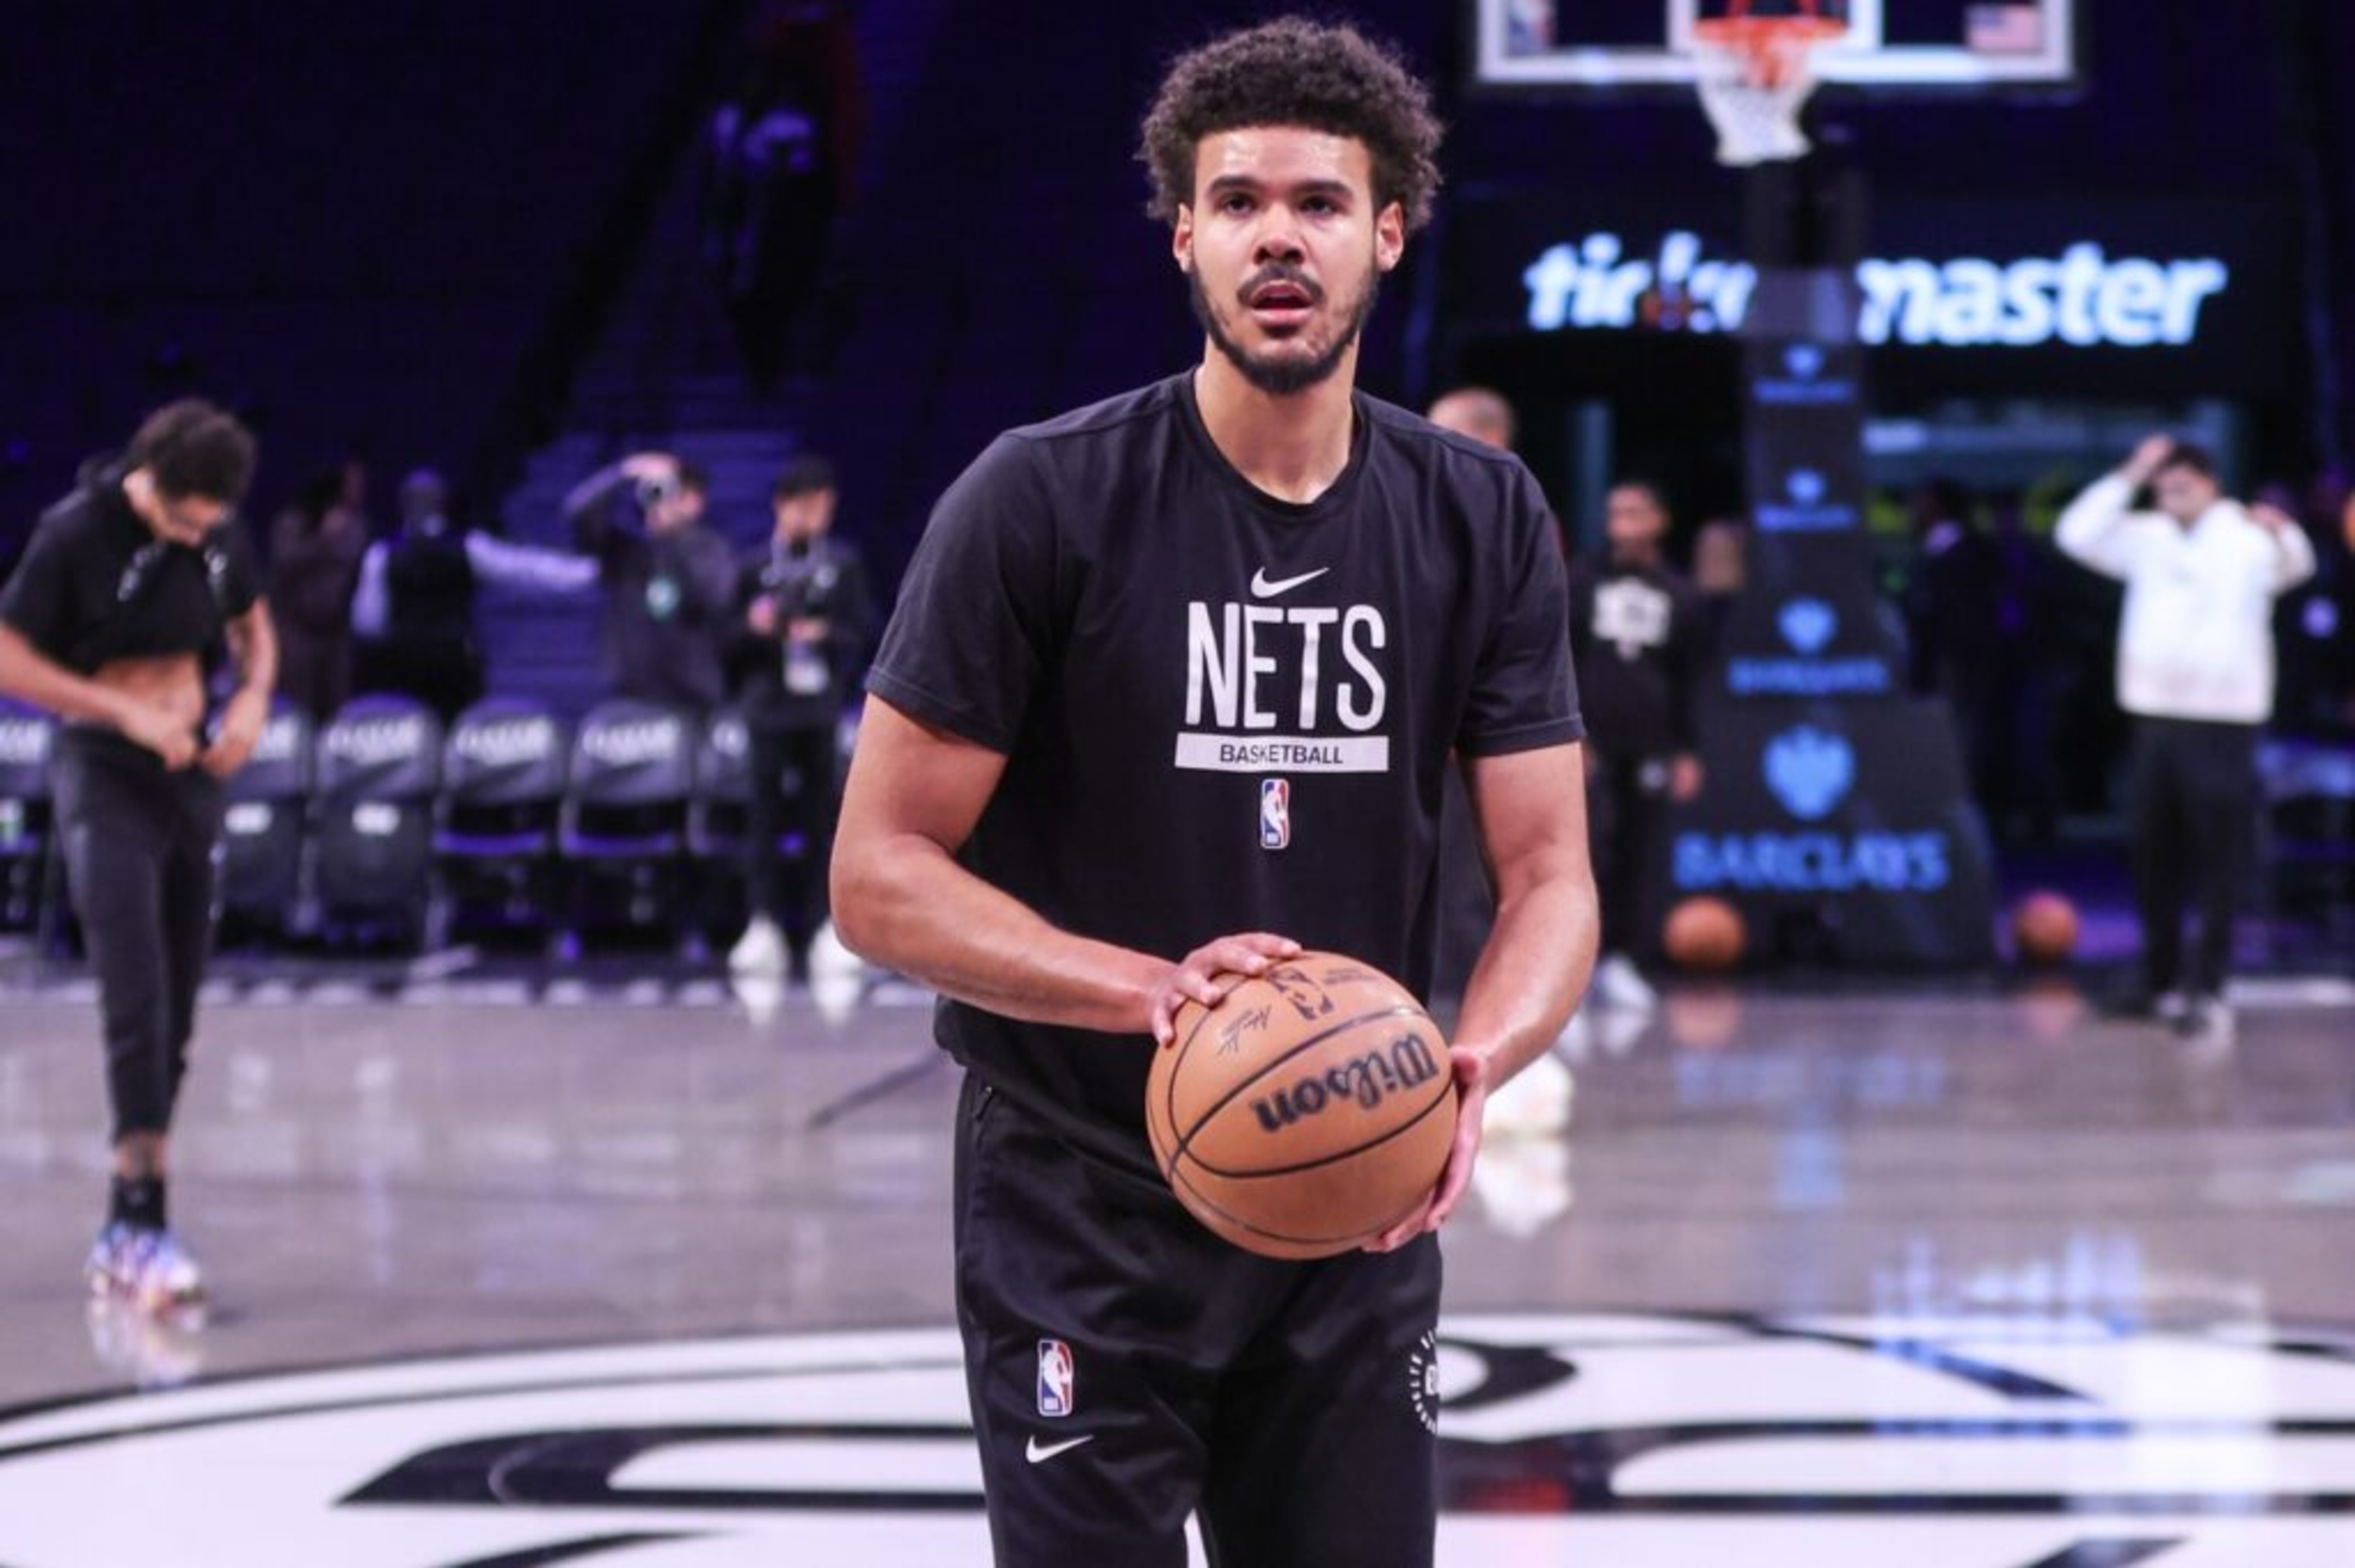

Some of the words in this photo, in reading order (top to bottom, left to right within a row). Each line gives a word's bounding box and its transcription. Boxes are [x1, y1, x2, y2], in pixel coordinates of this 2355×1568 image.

[1523, 232, 2227, 345] tickmaster
[1185, 601, 1387, 732] NETS
[1219, 744, 1343, 765] BASKETBALL
[1251, 1032, 1439, 1133] Wilson
